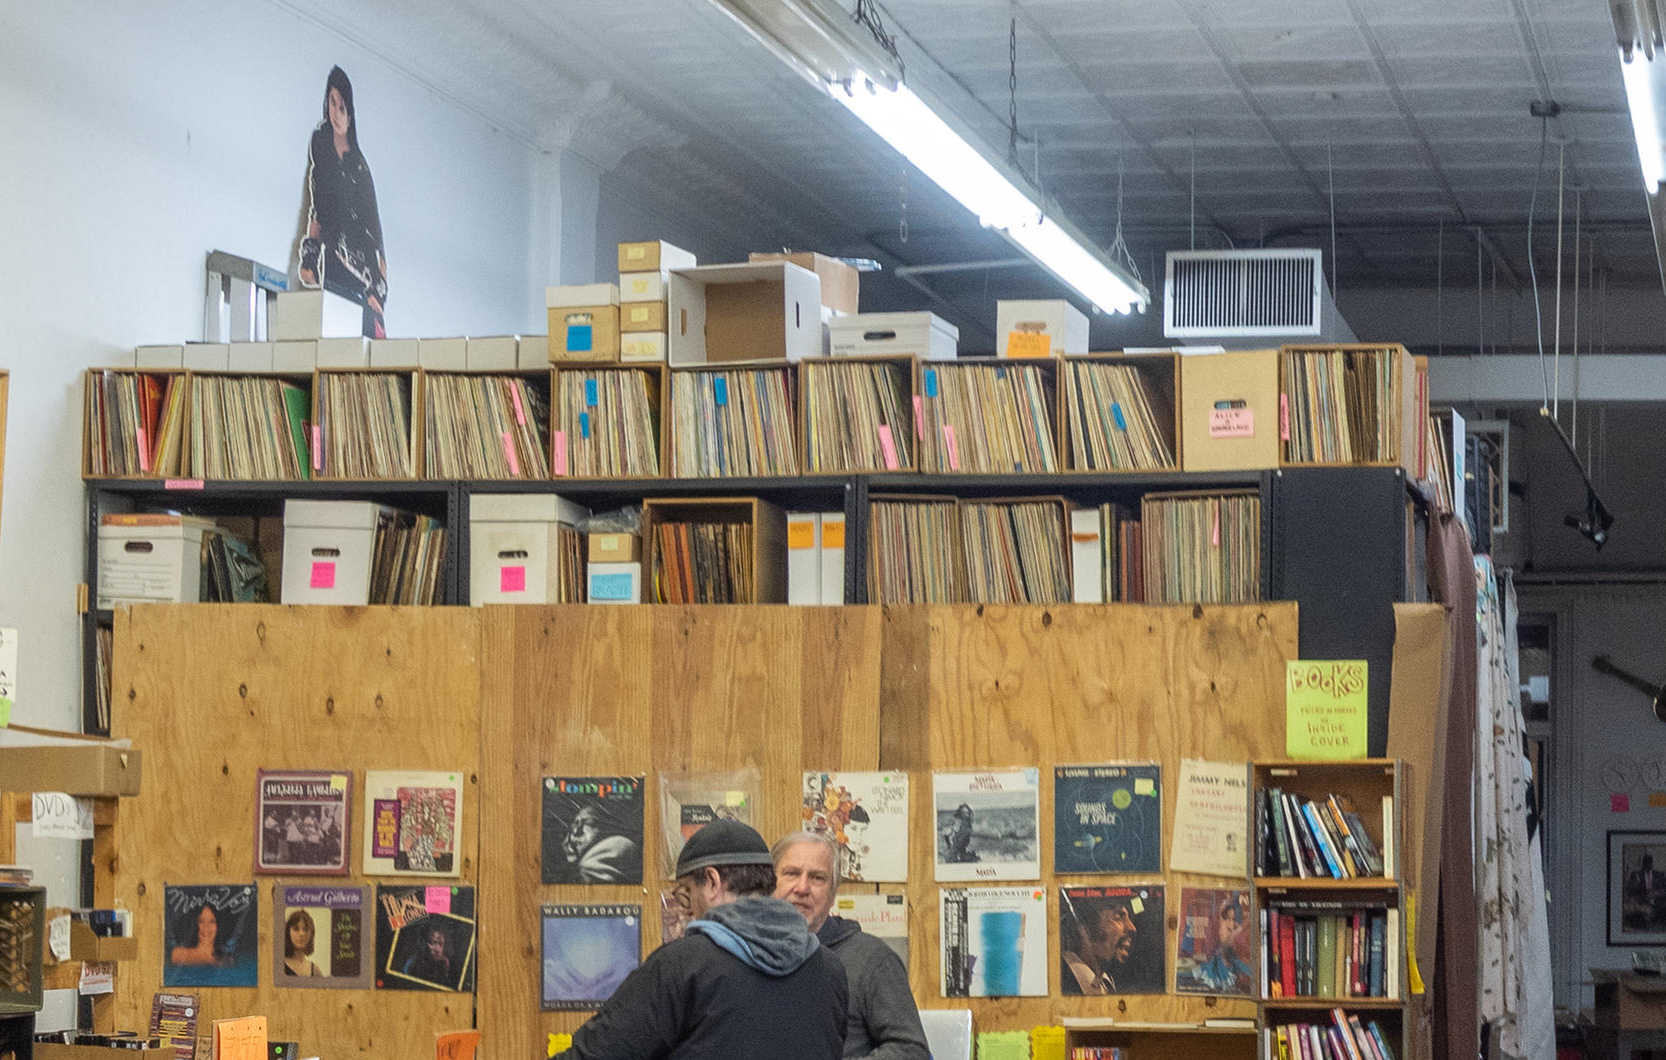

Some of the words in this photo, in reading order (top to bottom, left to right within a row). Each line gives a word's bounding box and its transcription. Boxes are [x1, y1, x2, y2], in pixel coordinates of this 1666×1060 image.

[1290, 663, 1365, 699] BOOKS
[1311, 735, 1349, 747] COVER
[1189, 775, 1220, 786] JIMMY
[1091, 813, 1117, 825] SPACE
[544, 906, 578, 915] WALLY
[584, 906, 640, 916] BADAROU
